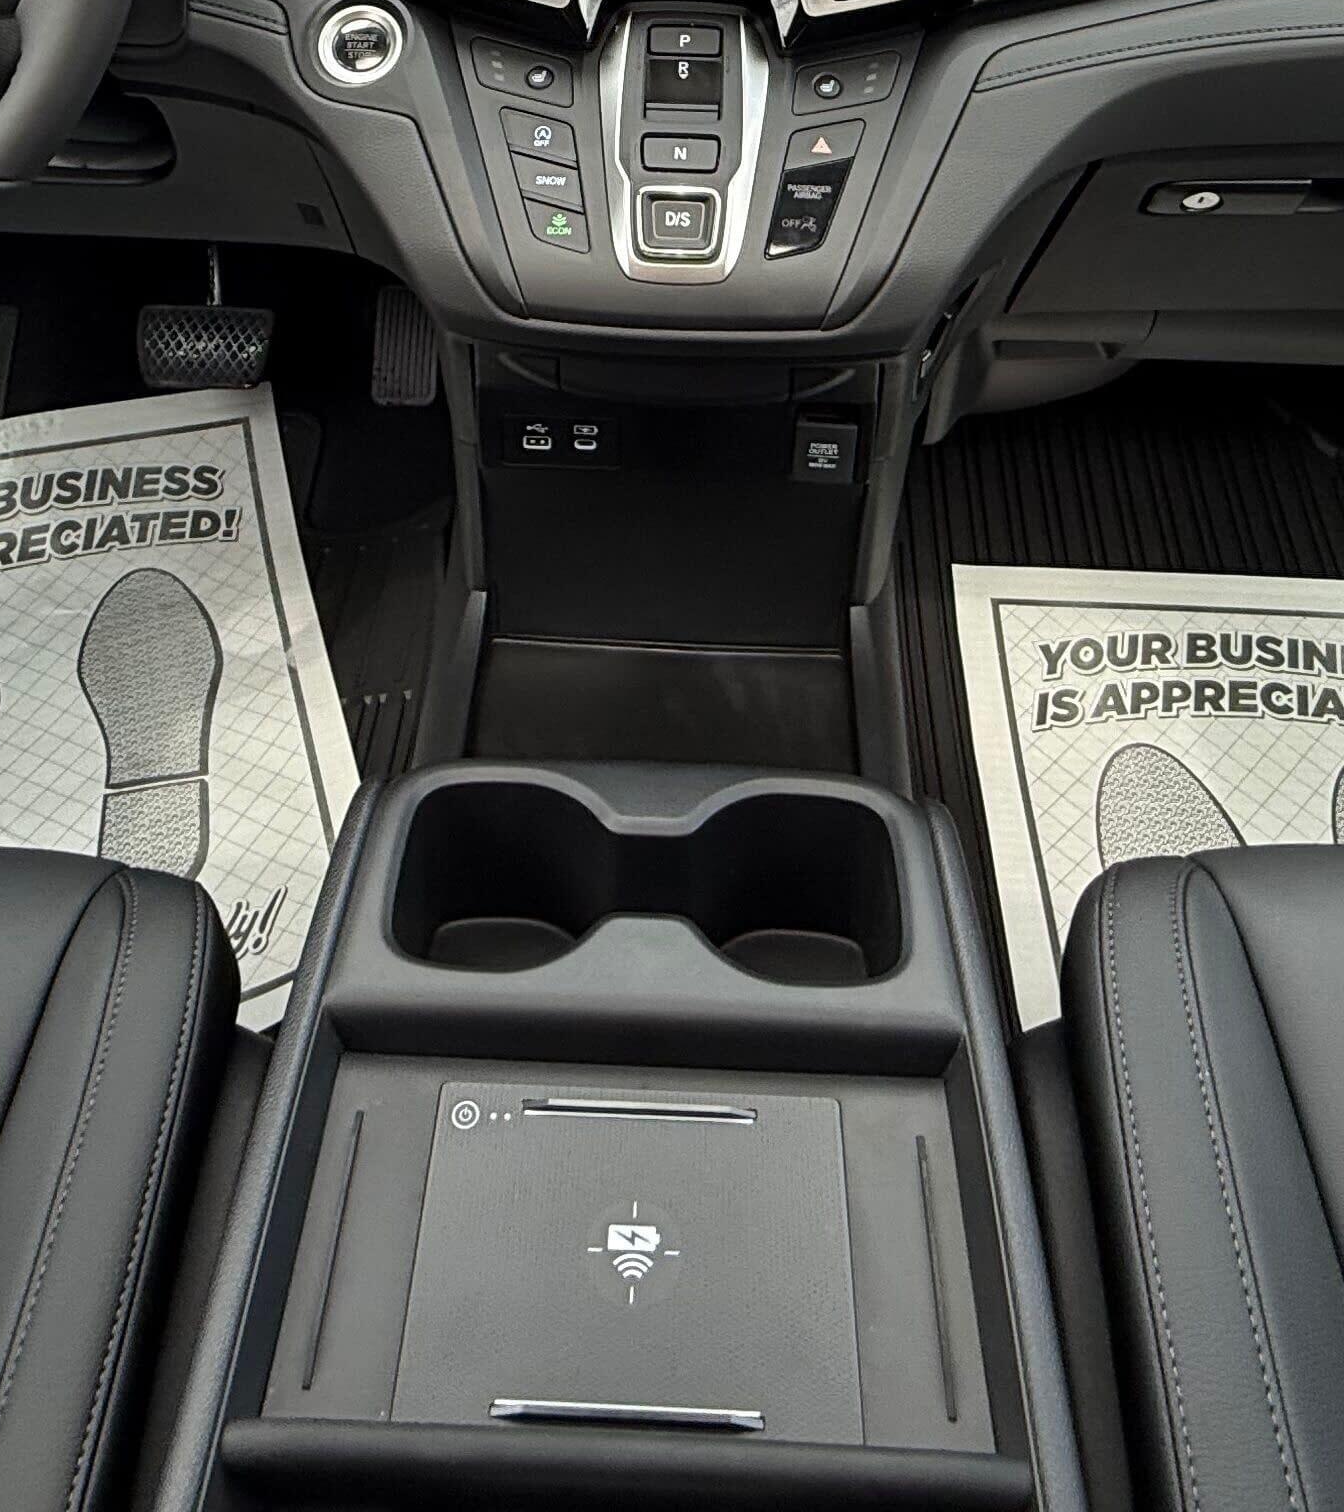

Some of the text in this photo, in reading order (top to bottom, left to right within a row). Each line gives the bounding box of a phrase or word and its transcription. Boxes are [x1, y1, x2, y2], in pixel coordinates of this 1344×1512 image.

[346, 41, 375, 49] START
[679, 34, 691, 48] P
[678, 61, 689, 74] R
[533, 139, 550, 147] OFF
[673, 147, 687, 161] N
[535, 175, 567, 186] SNOW
[665, 211, 692, 228] D/S
[782, 218, 801, 228] OFF
[546, 226, 572, 236] ECON
[1037, 632, 1175, 678] YOUR
[1034, 689, 1085, 727] IS
